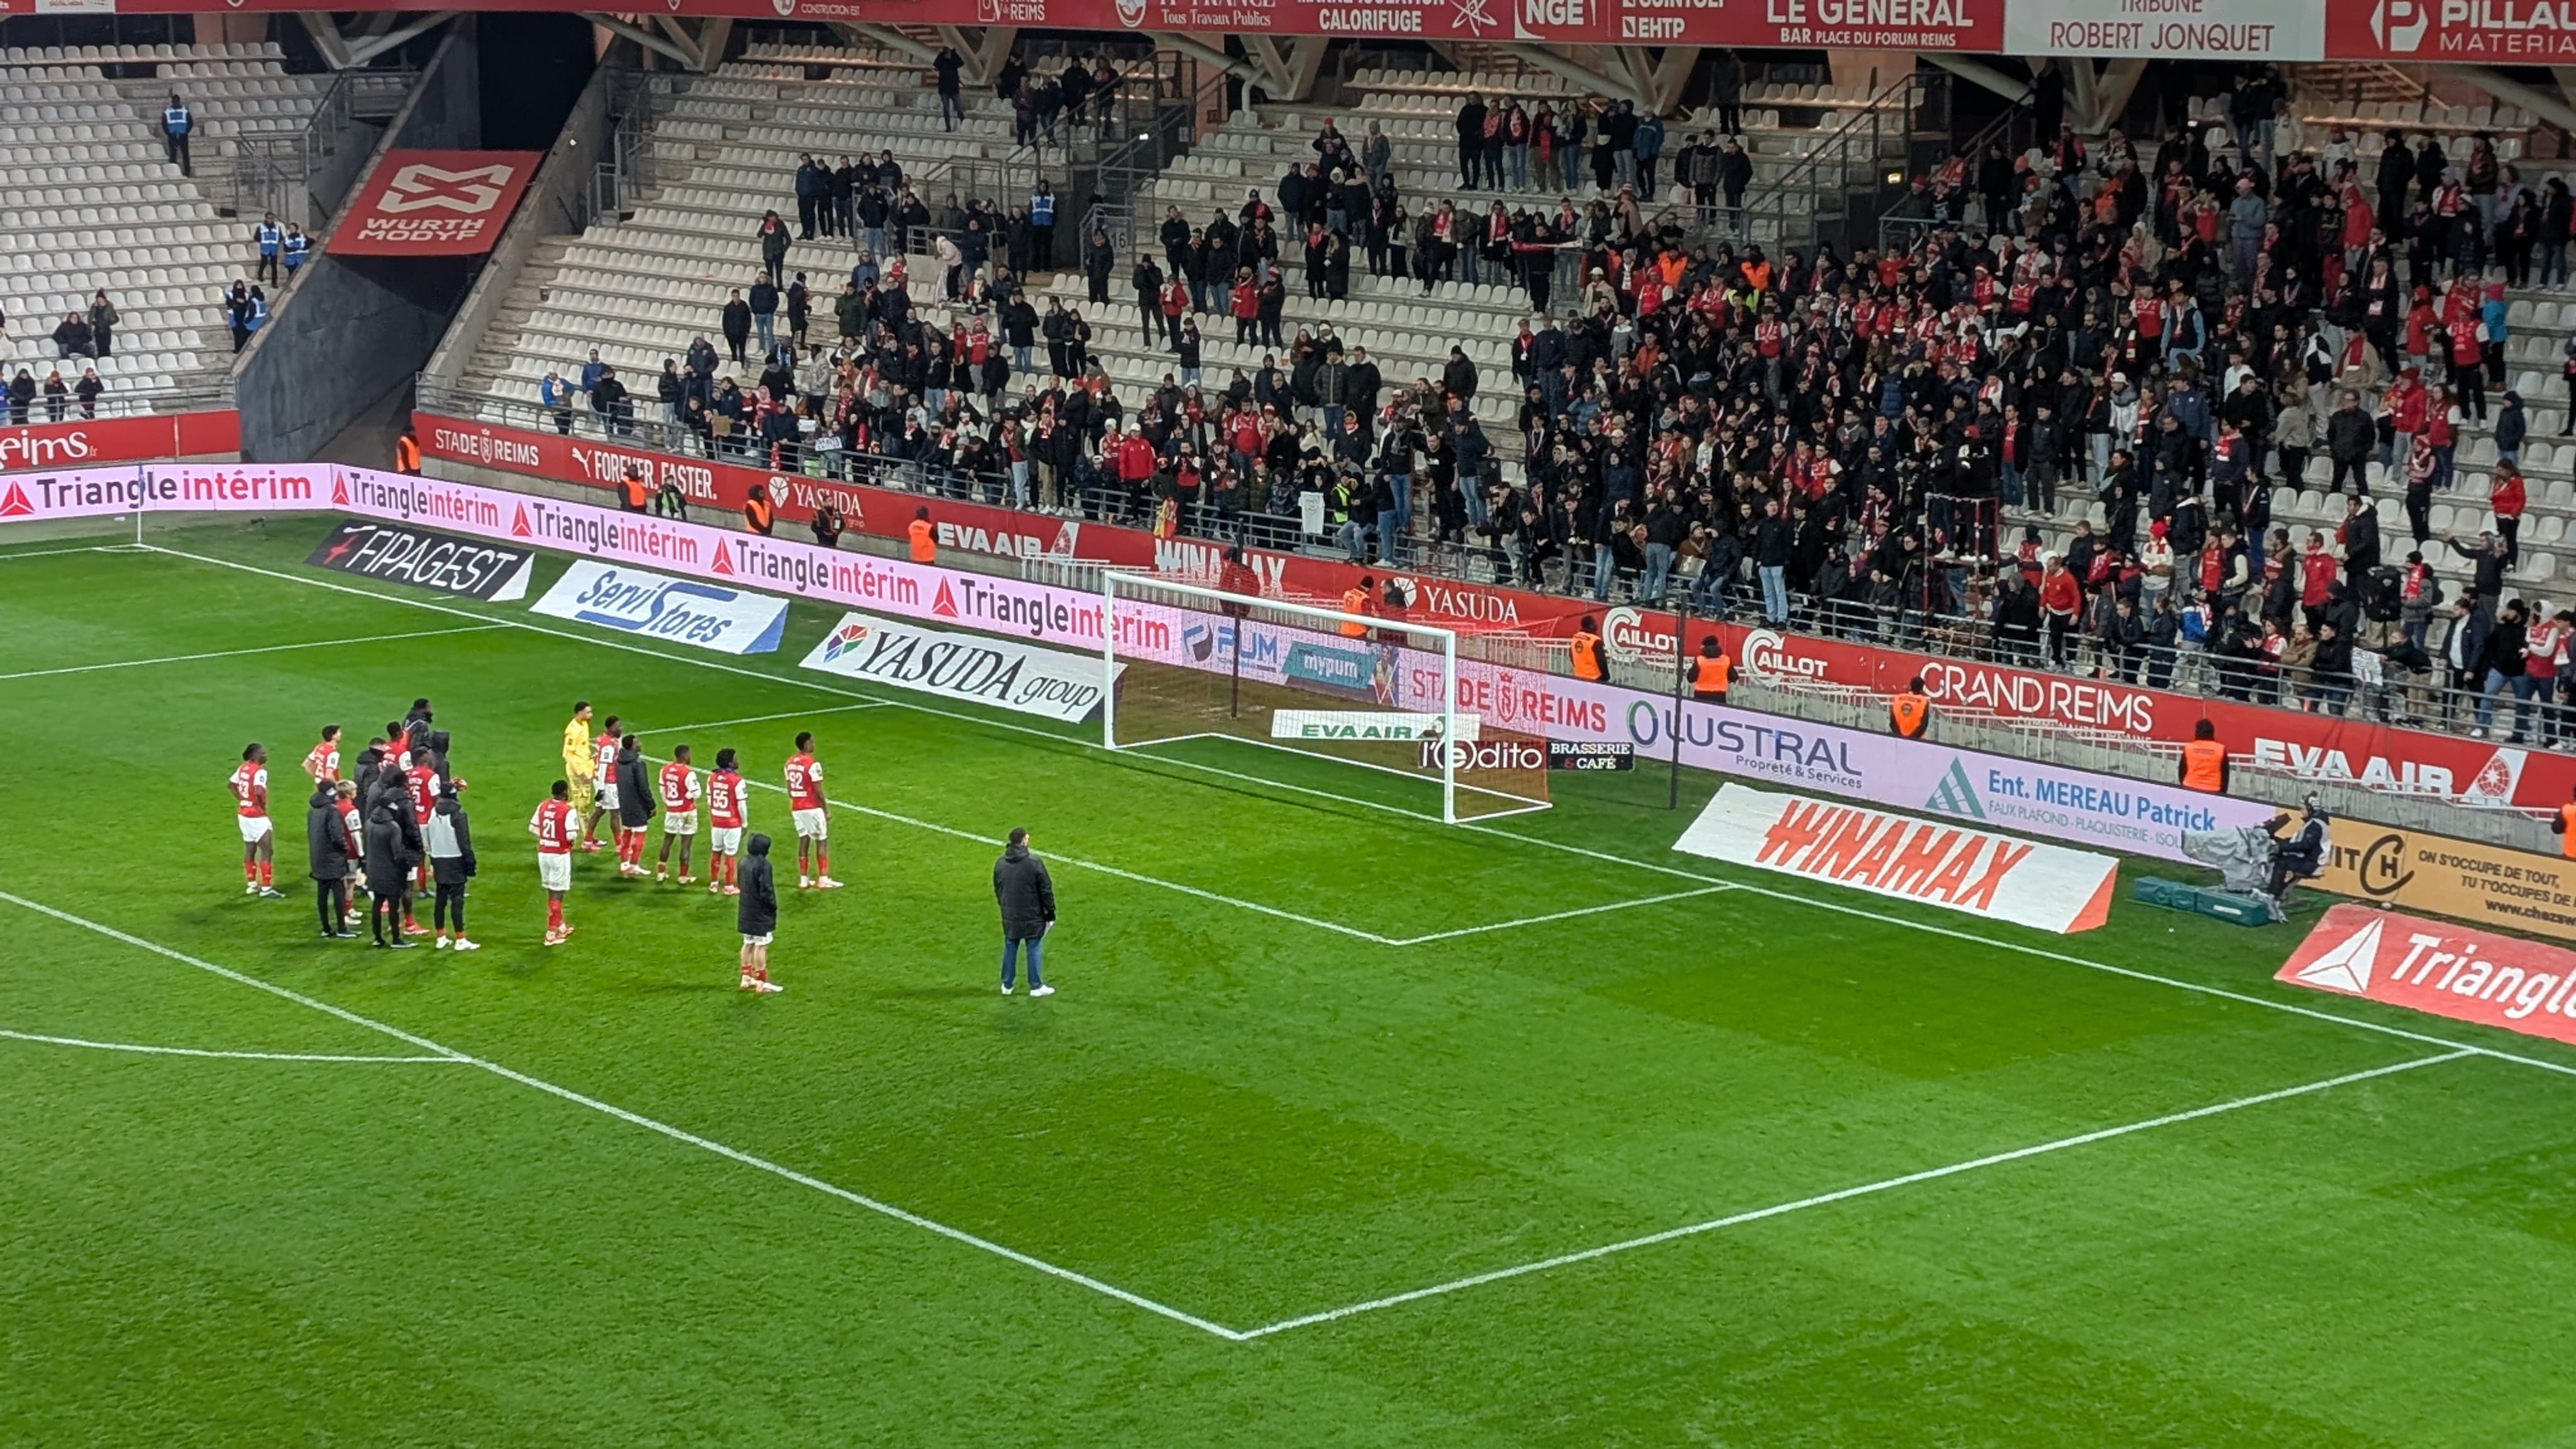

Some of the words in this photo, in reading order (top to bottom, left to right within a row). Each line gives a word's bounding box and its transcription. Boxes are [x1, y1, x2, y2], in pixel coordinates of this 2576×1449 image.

[1010, 3, 1045, 21] REIMS
[1161, 9, 1187, 24] Tous
[1190, 9, 1230, 25] Travaux
[1233, 10, 1271, 26] Publics
[1319, 8, 1422, 31] CALORIFUGE
[1526, 0, 1584, 25] NGE
[1639, 18, 1685, 38] EHTP
[1767, 0, 1806, 23] LE
[1780, 28, 1811, 43] BAR
[1816, 31, 1851, 44] PLACE
[1854, 31, 1872, 44] DU
[1875, 32, 1918, 46] FORUM
[1921, 33, 1957, 47] REIMS
[2050, 22, 2143, 48] ROBERT
[2150, 23, 2275, 52] JONQUET
[357, 230, 480, 241] MODYF
[435, 428, 479, 456] STADE
[494, 440, 540, 467] REIMS
[36, 471, 177, 509] Triangle
[182, 469, 311, 501] intérim
[350, 472, 428, 519] Triangle
[428, 485, 499, 527] intérim
[533, 502, 619, 553] Triangle
[619, 518, 698, 564] intérim
[345, 530, 518, 594] FIPAGEST
[736, 539, 829, 592] Triangle
[831, 556, 919, 606] intérim
[1155, 538, 1285, 597] WINAAX
[960, 578, 1069, 636] Triangle
[1423, 585, 1520, 626] YASUDA
[1218, 626, 1278, 663] PUM
[856, 631, 1027, 701] YASUDA
[1014, 675, 1099, 714] group
[1304, 653, 1358, 678] mypum
[1522, 689, 1606, 733] REIMS
[1920, 662, 2045, 714] GRAND
[2050, 681, 2153, 733] REIMS
[1550, 742, 1631, 755] BRASSERIE
[1576, 755, 1616, 770] CAFÉ
[789, 771, 804, 790] 92
[1735, 755, 1793, 776] Propreté
[1795, 765, 1805, 777] &
[1807, 768, 1863, 789] Services
[667, 780, 679, 799] 18
[713, 789, 729, 809] 55
[1989, 769, 2030, 799] Ent.
[2036, 778, 2129, 816] MEREAU
[2136, 796, 2216, 831] Patrick
[543, 818, 556, 839] 21
[1989, 801, 2017, 817] FAUX
[2018, 806, 2069, 826] PLAFOND
[2077, 818, 2148, 843] PLAQUISTERIE
[1755, 799, 2034, 911] WINAMAX
[2418, 850, 2438, 863] ON
[2438, 853, 2501, 876] S'OCCUPE
[2504, 865, 2522, 879] DE
[2525, 870, 2560, 889] TOUT,
[2462, 875, 2477, 889] TU
[2480, 878, 2551, 902] T'OCCUPES
[2553, 890, 2570, 906] DE
